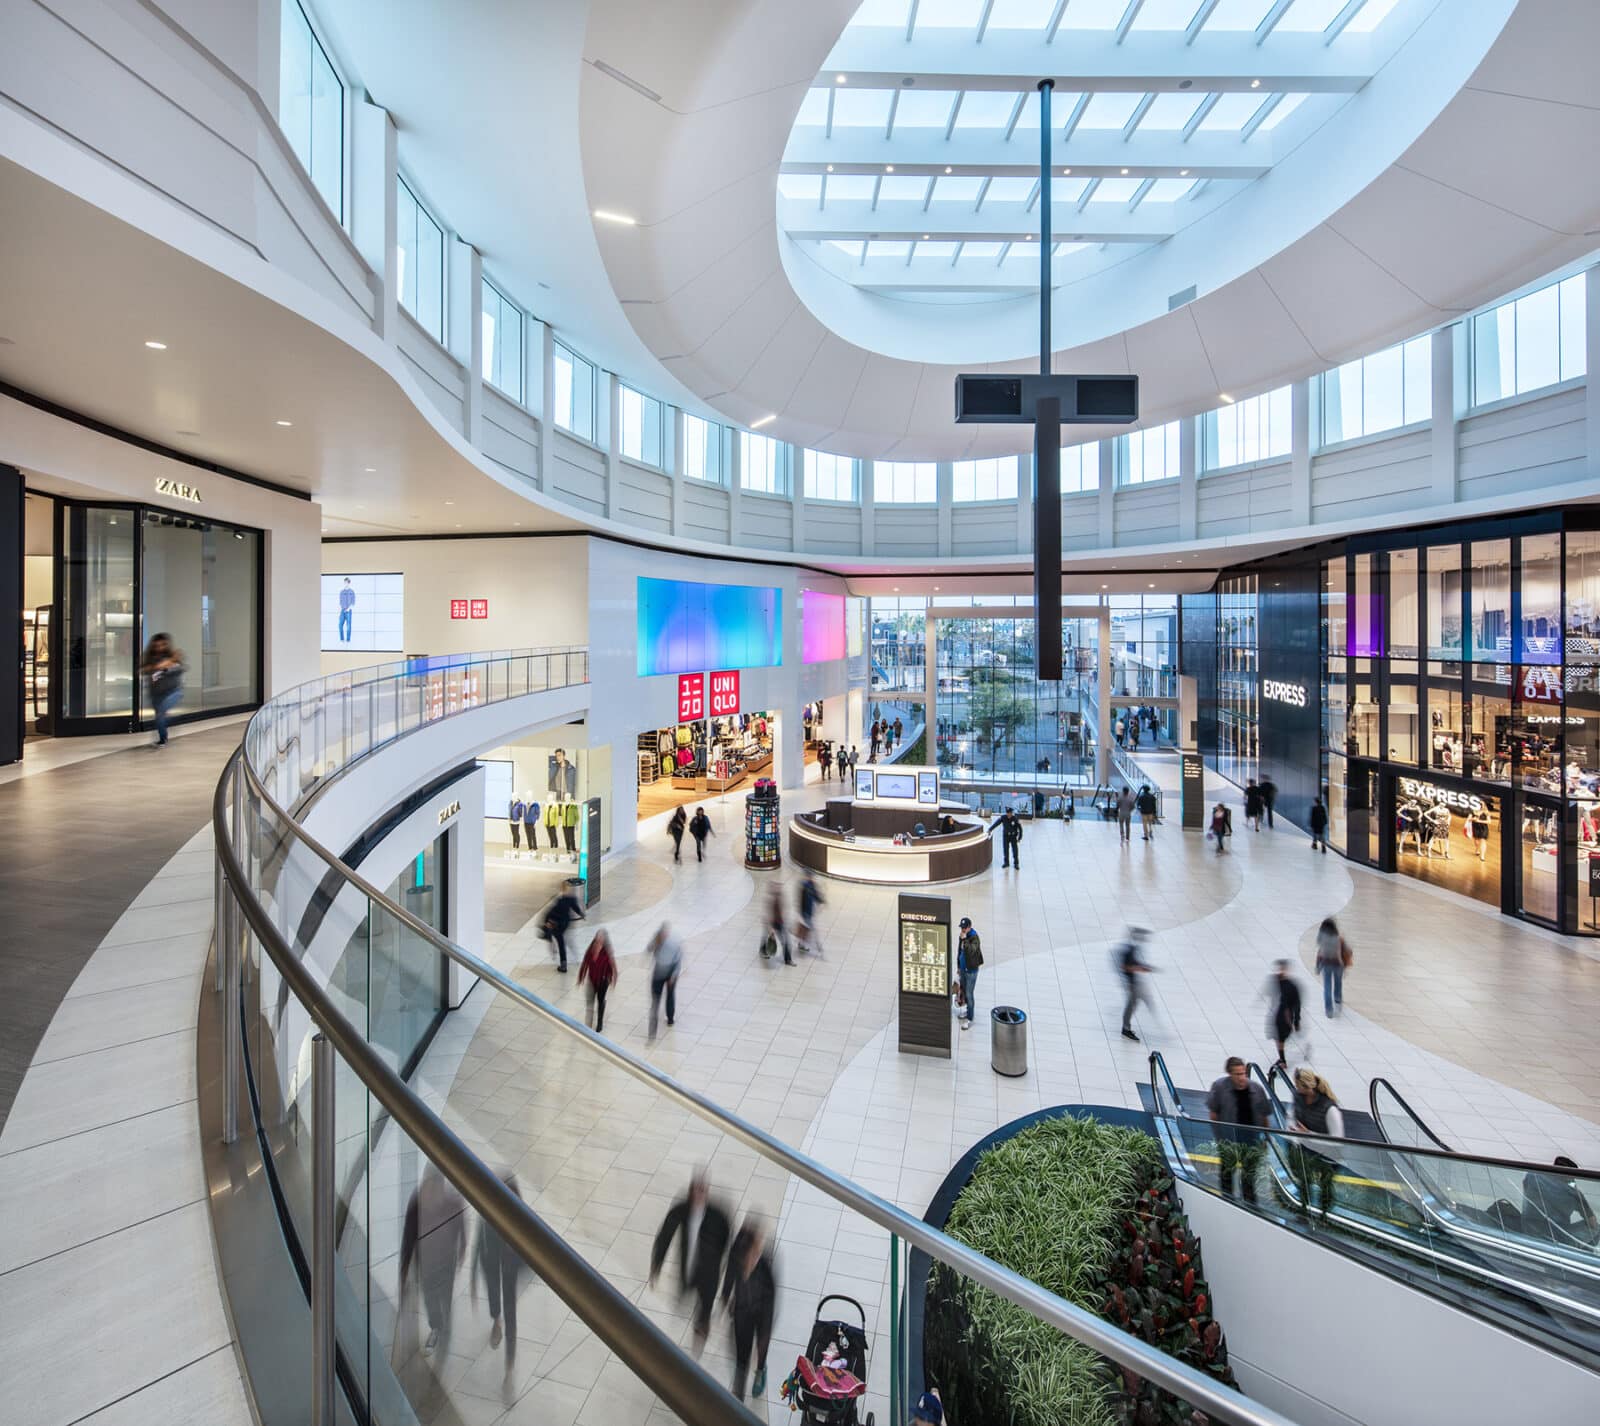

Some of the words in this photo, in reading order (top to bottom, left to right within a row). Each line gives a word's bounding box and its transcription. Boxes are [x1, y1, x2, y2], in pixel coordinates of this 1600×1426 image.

[156, 478, 202, 503] ZARA
[714, 677, 734, 692] UNI
[1264, 680, 1305, 707] EXPRESS
[714, 694, 736, 712] QLO
[1405, 783, 1482, 810] EXPRESS
[901, 913, 936, 921] DIRECTORY
